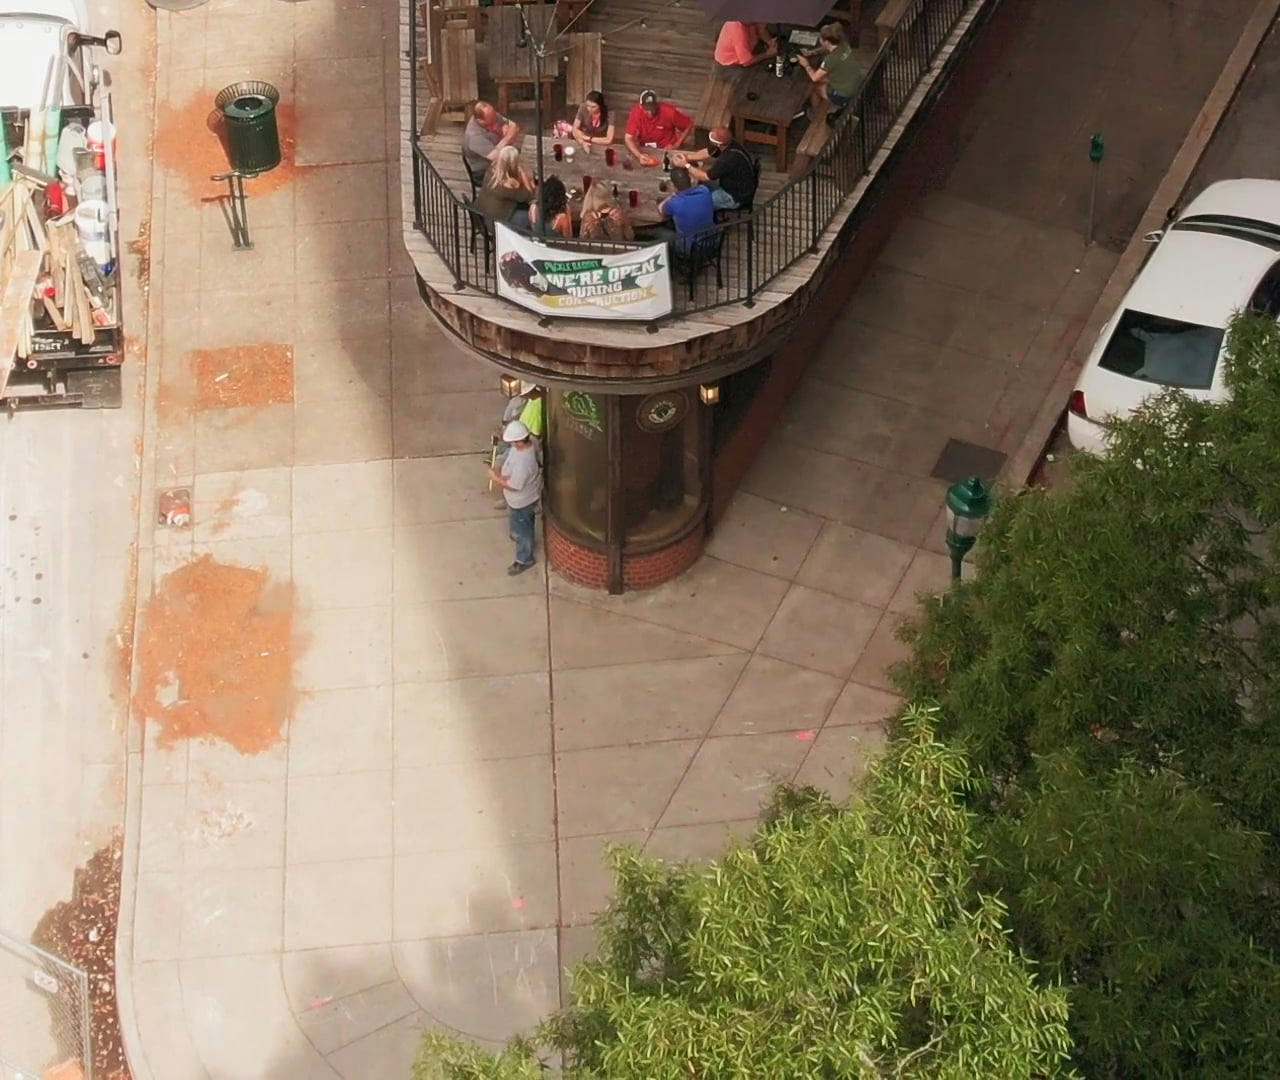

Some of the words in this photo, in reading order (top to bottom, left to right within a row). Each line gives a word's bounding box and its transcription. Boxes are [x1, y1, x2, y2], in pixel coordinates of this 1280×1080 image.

[546, 270, 604, 288] WE'RE
[609, 259, 655, 283] OPEN
[567, 281, 622, 298] DURING
[558, 290, 648, 307] CONRUCTION
